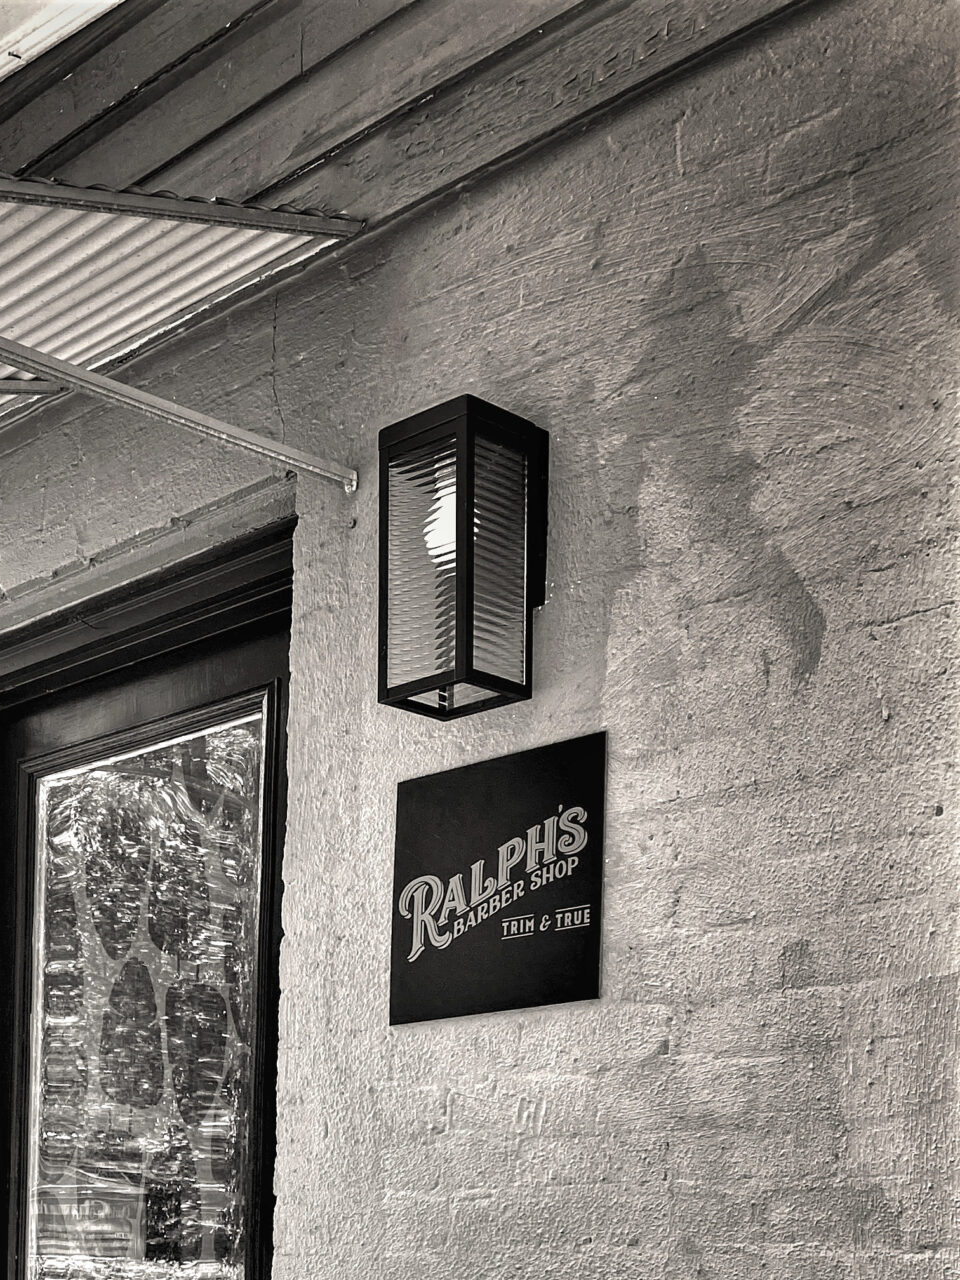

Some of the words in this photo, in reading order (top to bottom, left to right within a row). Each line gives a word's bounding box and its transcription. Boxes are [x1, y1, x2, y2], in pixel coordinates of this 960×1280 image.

[398, 804, 588, 963] RALPH'S
[453, 880, 525, 939] BARBER
[530, 856, 579, 891] SHOP
[501, 918, 535, 936] TRIM
[540, 914, 551, 932] &
[555, 908, 590, 925] TRUE
